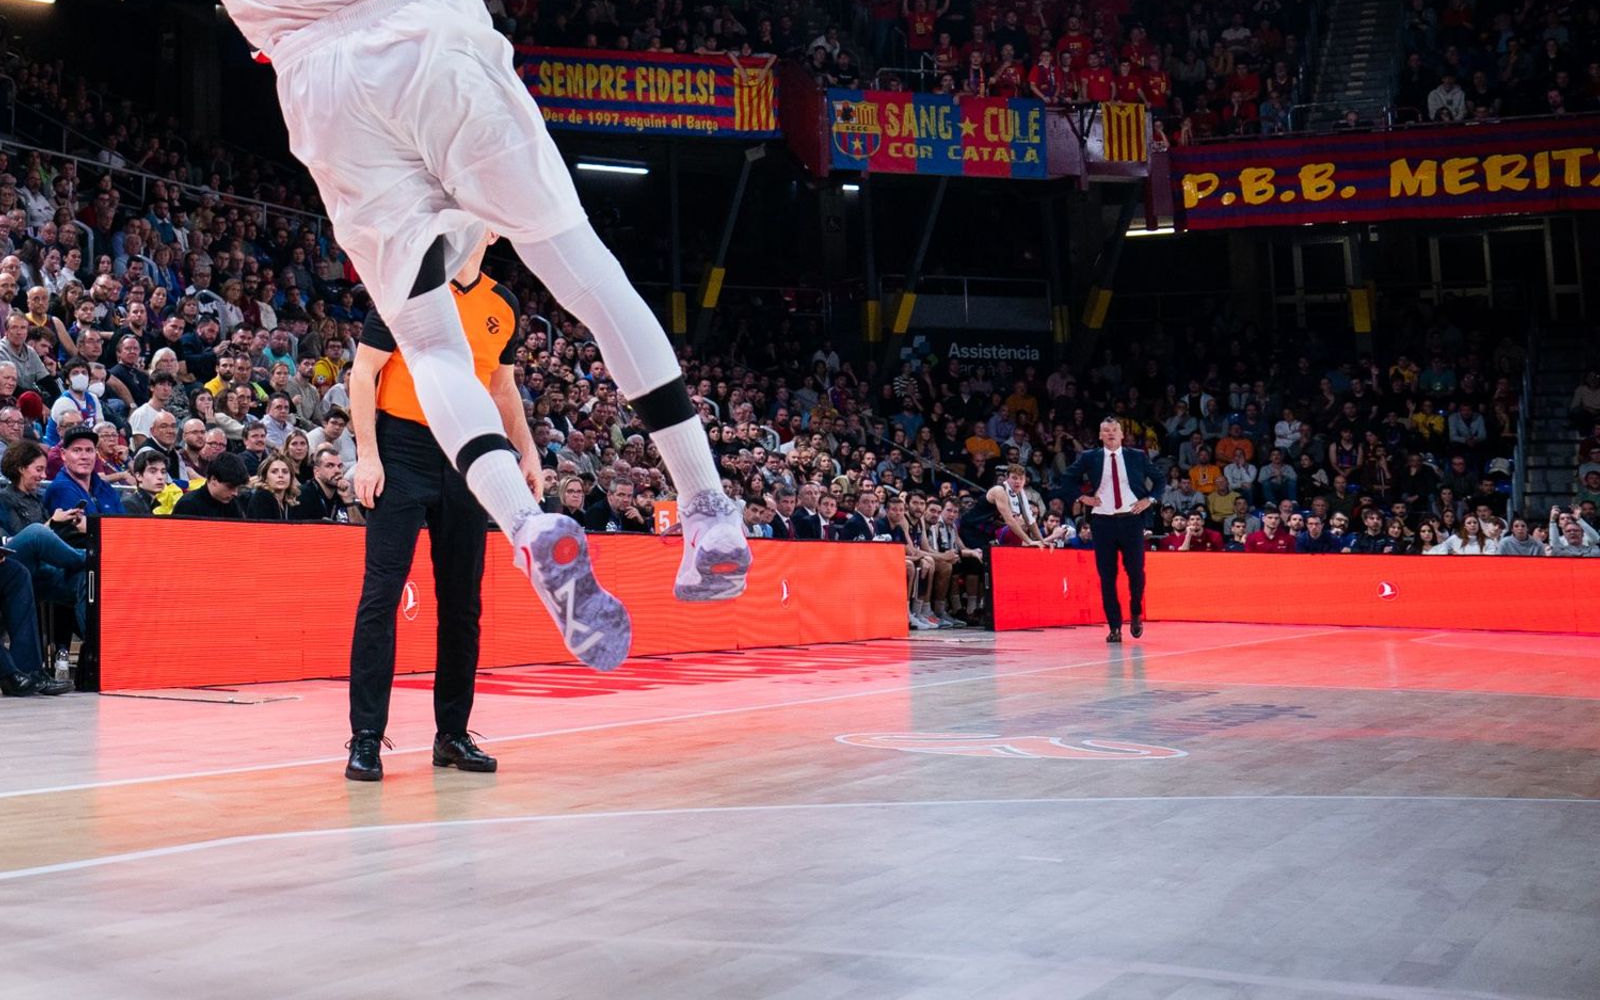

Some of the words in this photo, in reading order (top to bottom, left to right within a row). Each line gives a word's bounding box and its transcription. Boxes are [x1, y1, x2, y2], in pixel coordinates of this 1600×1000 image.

[539, 61, 628, 100] SEMPRE
[636, 67, 716, 105] FIDELS!
[543, 108, 564, 122] Des
[568, 109, 583, 124] de
[588, 112, 620, 127] 1997
[624, 114, 667, 131] seguint
[672, 115, 682, 129] al
[686, 115, 719, 134] Barça
[885, 103, 952, 140] SANG
[984, 107, 1041, 143] CULÉ
[888, 142, 933, 159] COR
[948, 145, 1040, 163] CATALÀ
[1182, 162, 1357, 209] P.B.B.
[1390, 147, 1600, 199] MERIT
[948, 342, 1040, 361] Assistència
